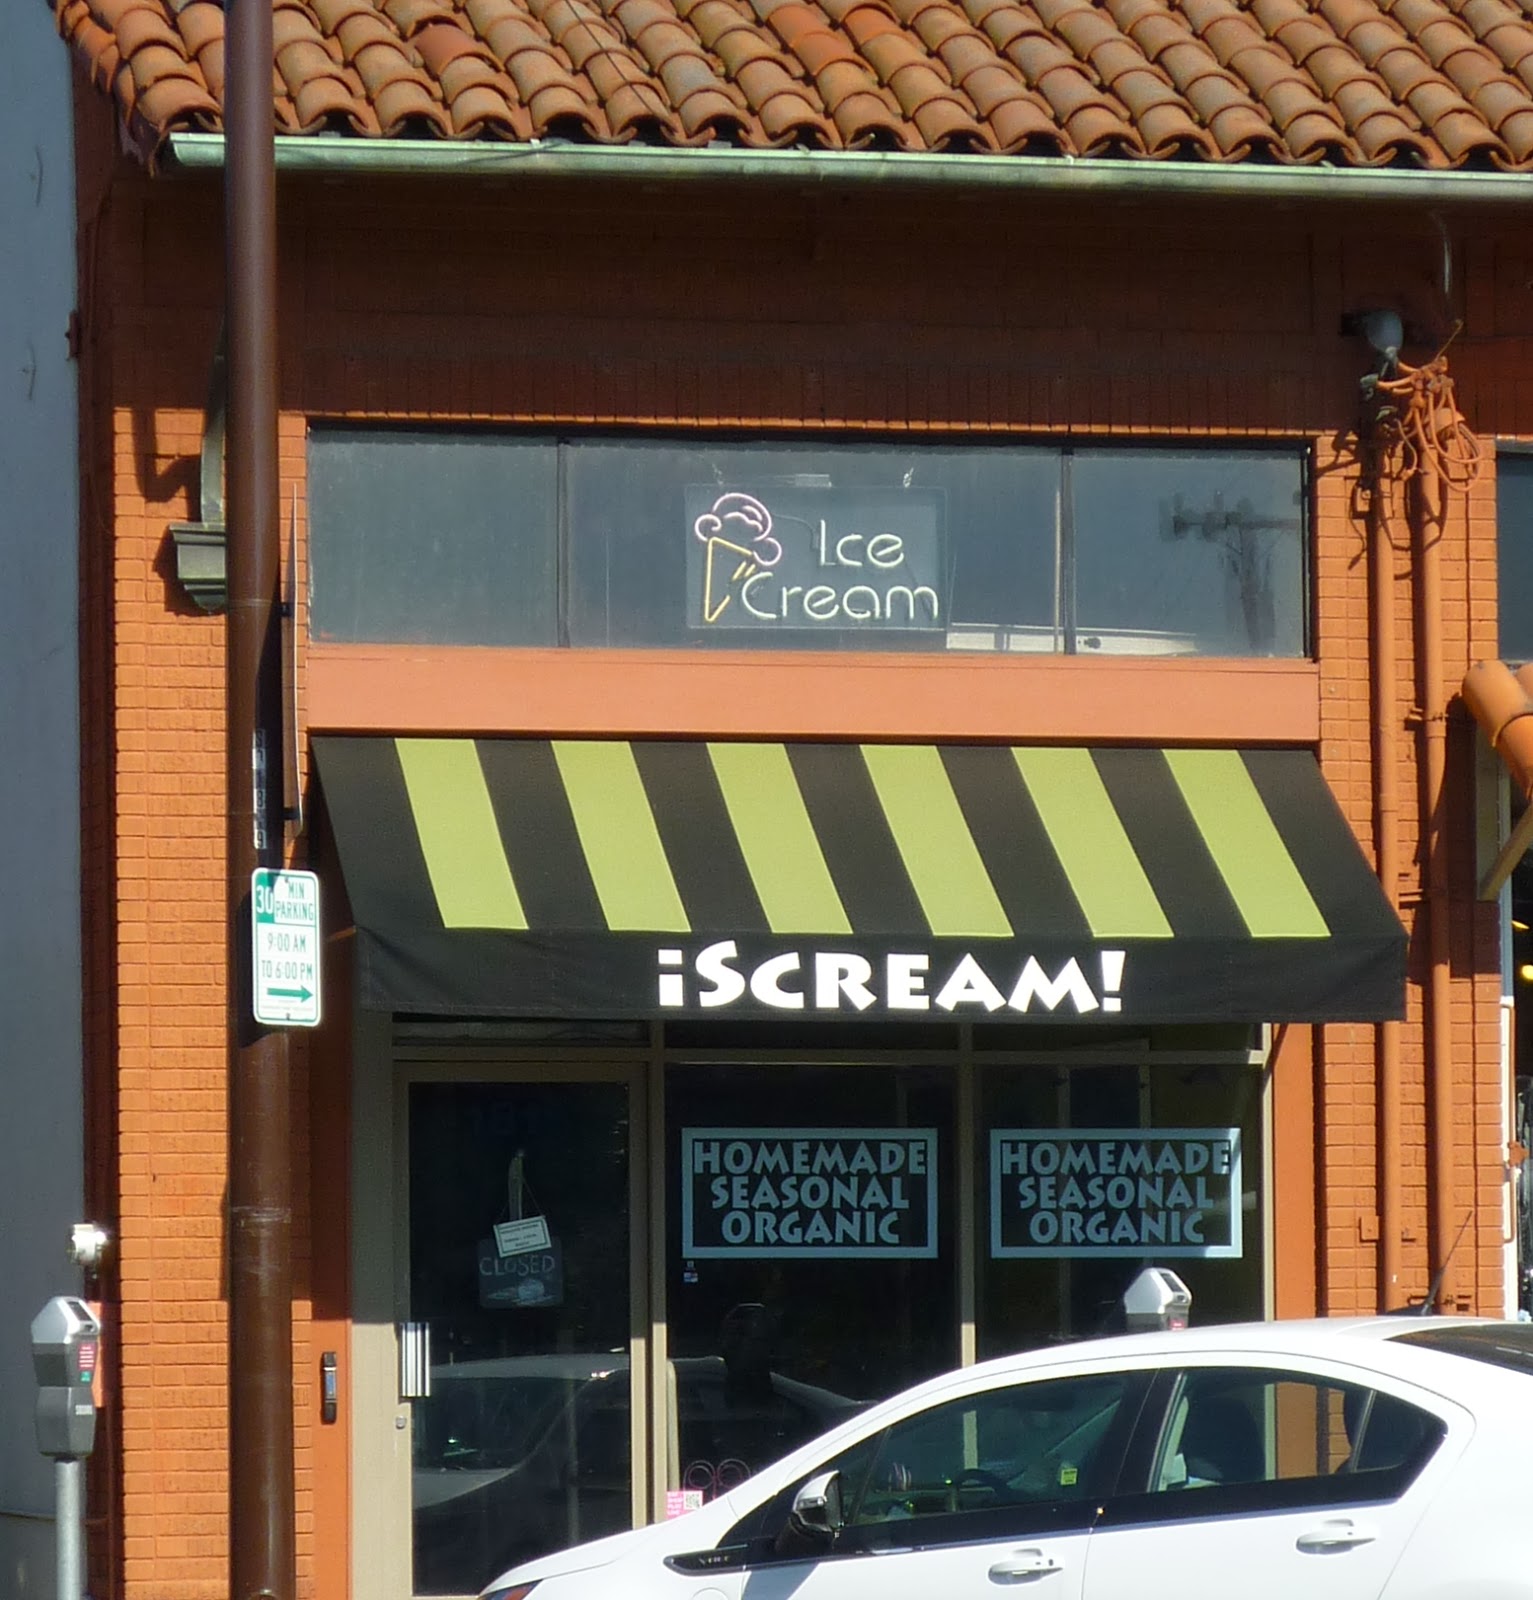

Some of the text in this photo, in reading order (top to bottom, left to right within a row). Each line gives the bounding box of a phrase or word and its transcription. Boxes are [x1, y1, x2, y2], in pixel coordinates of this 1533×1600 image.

[820, 519, 904, 568] Ice
[741, 571, 938, 620] Cream
[256, 881, 305, 914] 30 MIN
[275, 901, 314, 921] PARKING
[267, 933, 307, 953] 9:00 AM
[261, 960, 313, 981] TO 6:00 PM
[694, 1141, 926, 1175] HOMEMADE
[1001, 1141, 1230, 1175] HOMEMADE
[710, 1175, 909, 1210] SEASONAL
[1018, 1175, 1214, 1210] SEASONAL
[721, 1210, 900, 1244] ORGANIC
[1029, 1210, 1205, 1244] ORGANIC
[479, 1255, 555, 1277] CLOSED
